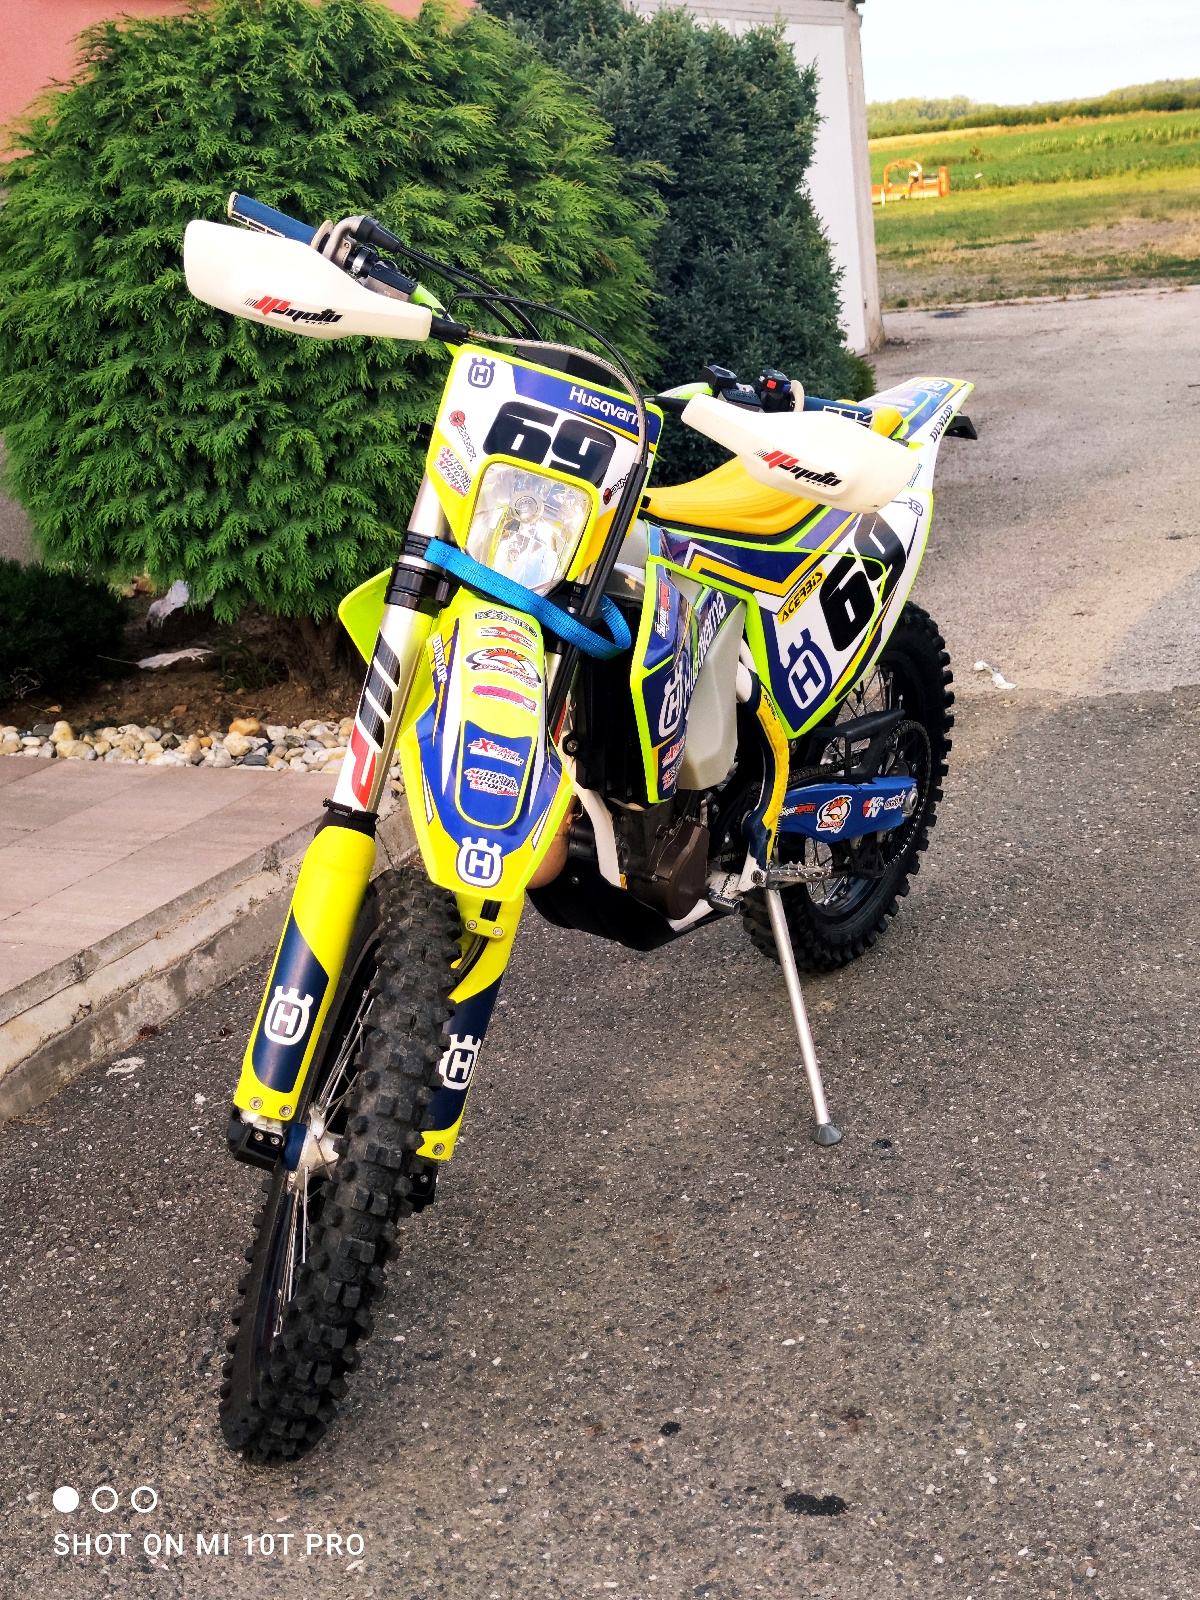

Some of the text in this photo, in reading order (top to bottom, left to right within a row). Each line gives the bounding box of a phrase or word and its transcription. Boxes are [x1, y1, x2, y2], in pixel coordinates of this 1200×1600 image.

[569, 385, 649, 427] Husqvarn
[929, 404, 954, 442] DUNLOP
[482, 401, 617, 489] 69
[782, 571, 824, 622] ACERBIS
